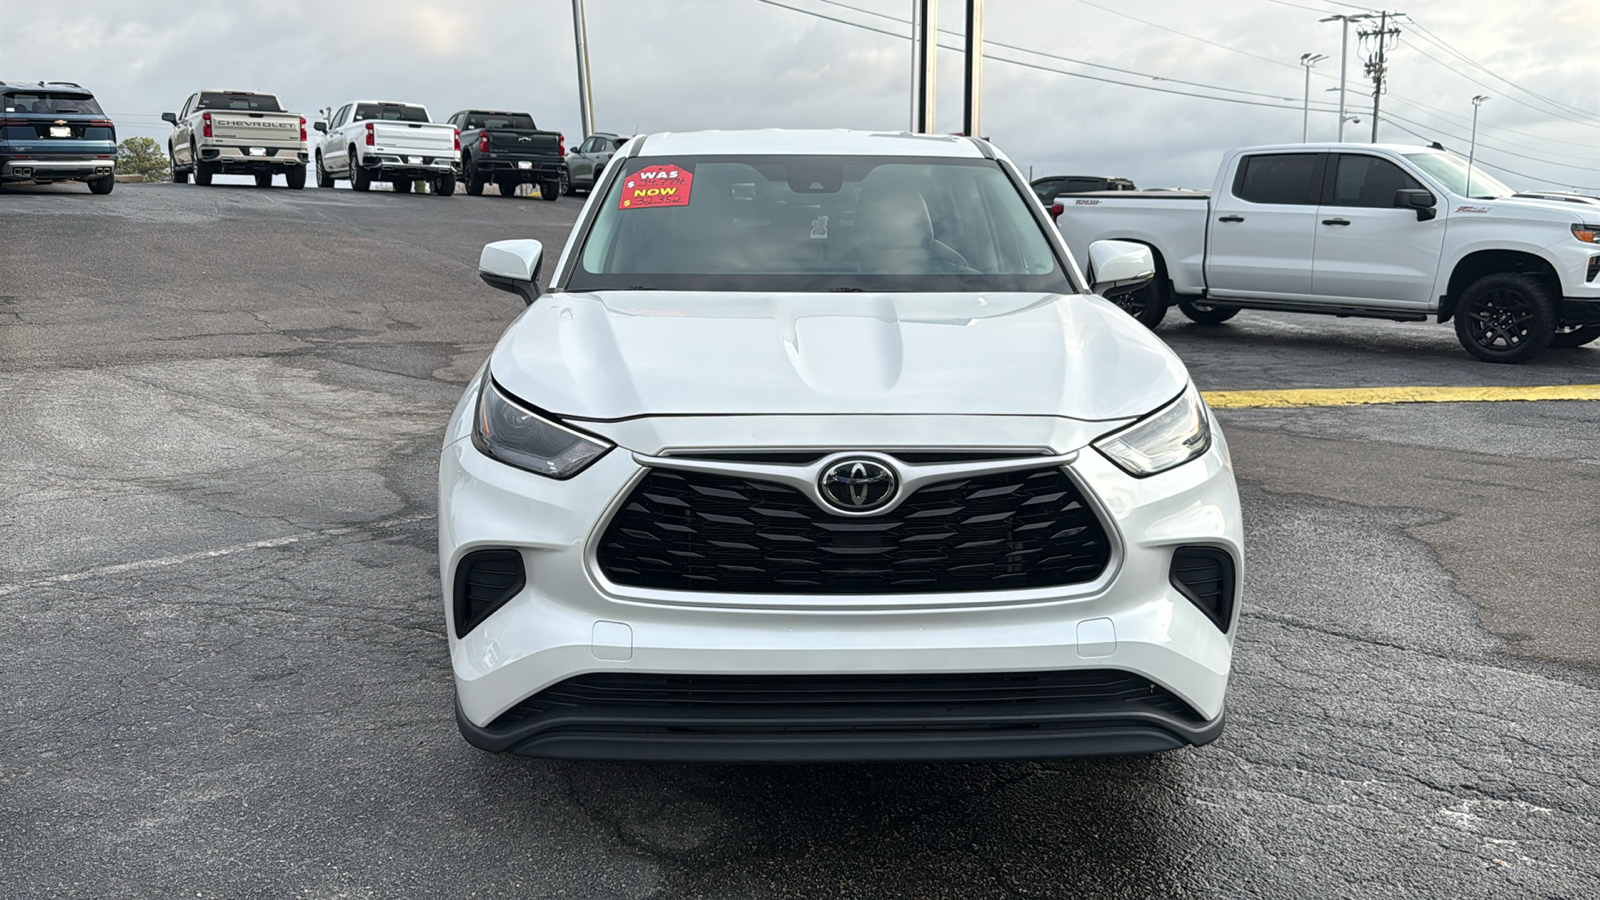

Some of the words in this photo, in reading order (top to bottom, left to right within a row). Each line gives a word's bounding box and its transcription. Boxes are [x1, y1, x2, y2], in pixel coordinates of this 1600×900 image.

[217, 120, 295, 128] CHEVROLET
[640, 171, 679, 179] WAS
[634, 188, 677, 197] NOW
